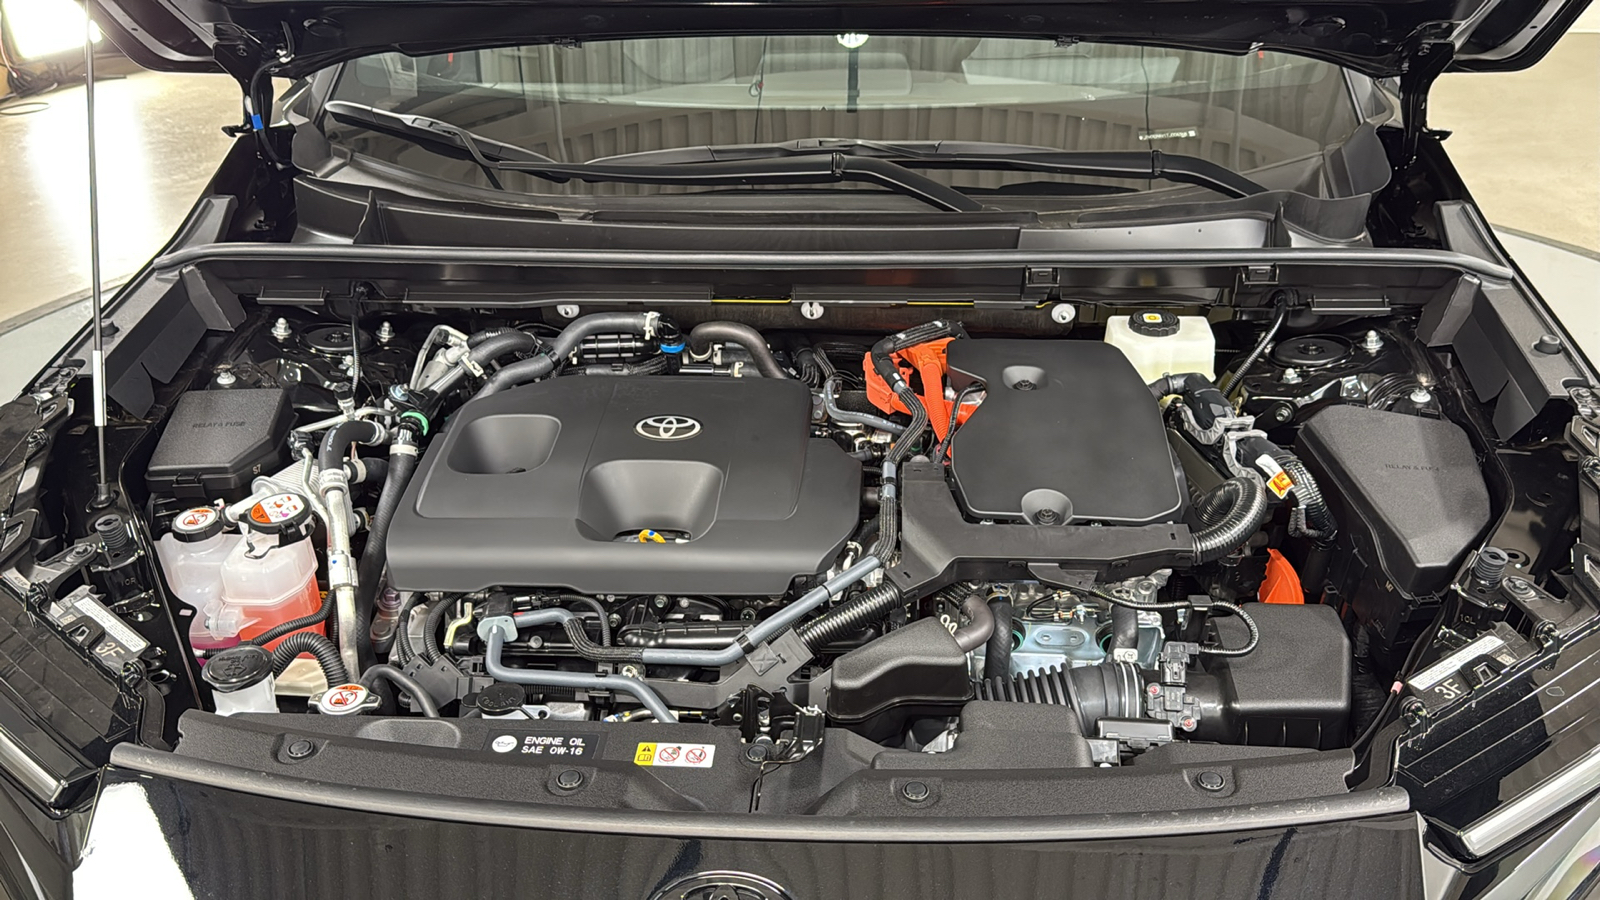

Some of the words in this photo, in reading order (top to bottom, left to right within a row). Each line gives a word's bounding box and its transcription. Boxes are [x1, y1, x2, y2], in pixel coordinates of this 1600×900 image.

[192, 421, 219, 429] RELAY
[95, 641, 126, 658] 3F
[1434, 678, 1462, 700] 3F
[523, 736, 564, 746] ENGINE
[568, 737, 586, 747] OIL
[520, 745, 544, 754] SAE
[549, 746, 584, 756] 0W-16
